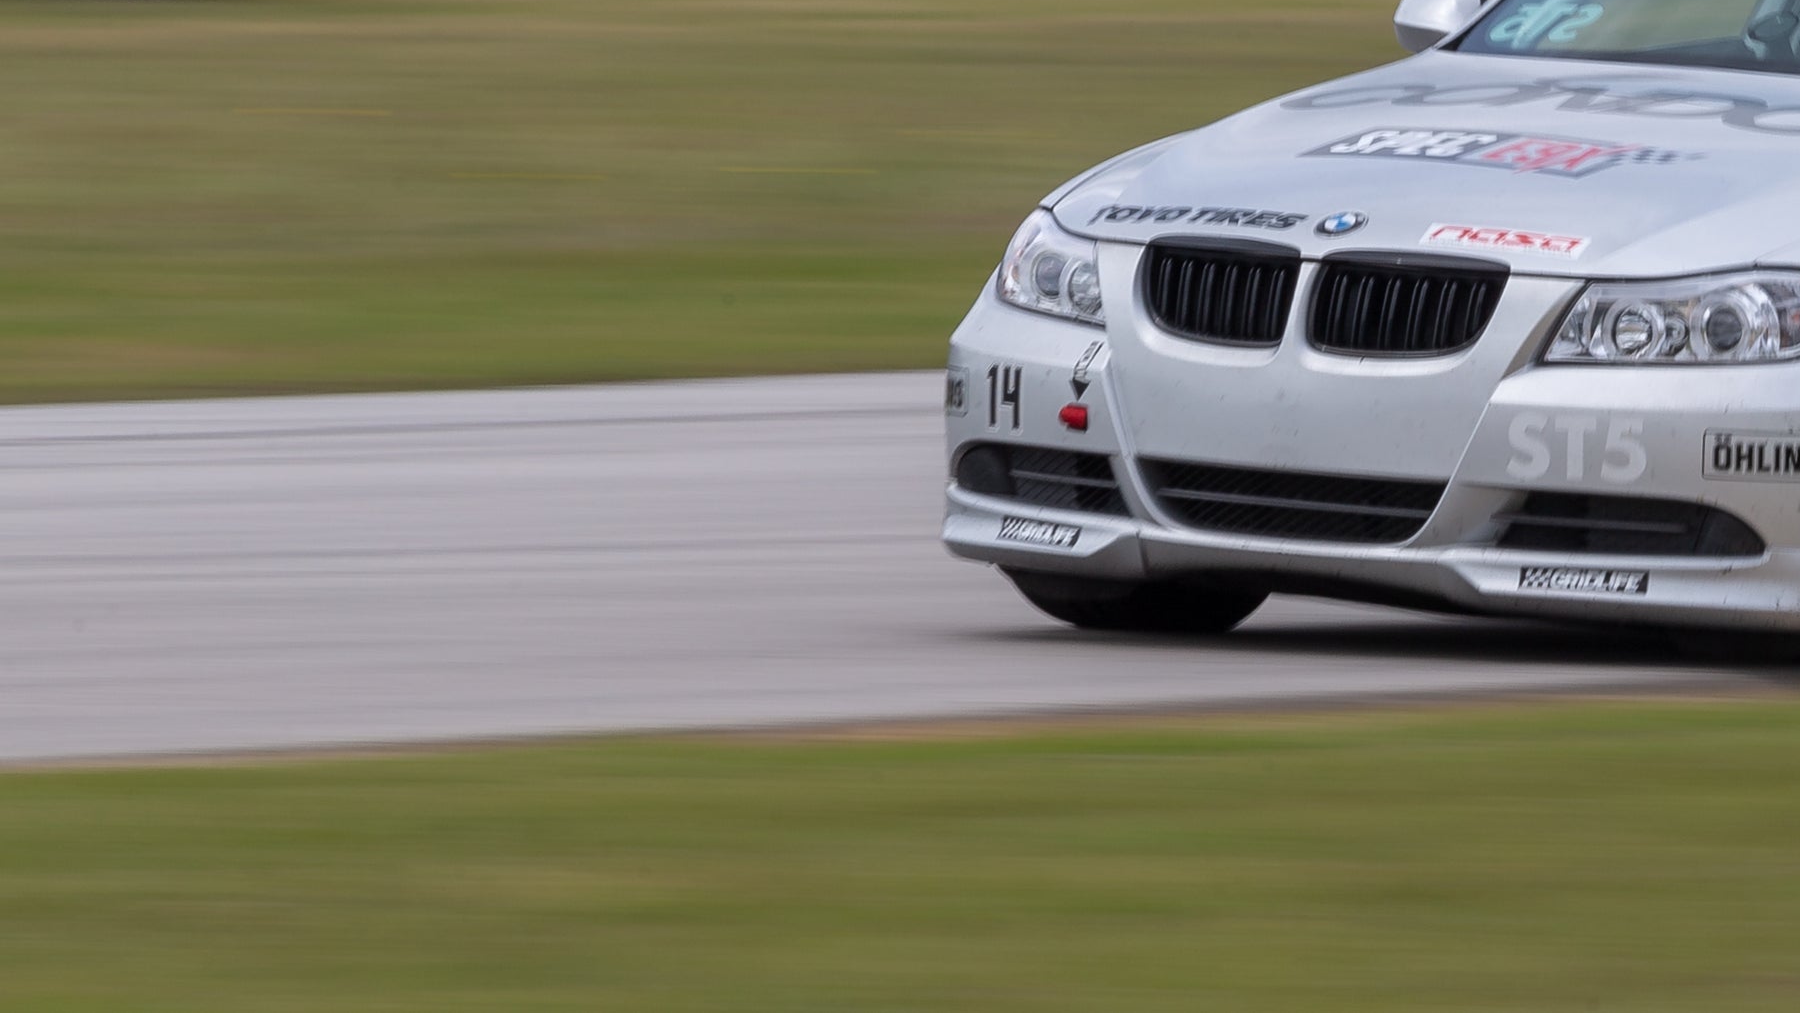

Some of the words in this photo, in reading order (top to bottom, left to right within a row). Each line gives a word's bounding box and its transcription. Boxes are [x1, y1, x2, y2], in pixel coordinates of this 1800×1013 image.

[1328, 129, 1500, 158] SPEC
[1087, 205, 1193, 227] TOYO
[1187, 206, 1309, 231] TIRES
[986, 362, 1023, 434] 14
[1506, 410, 1649, 484] ST5
[1549, 570, 1645, 592] GRIDLIFE
